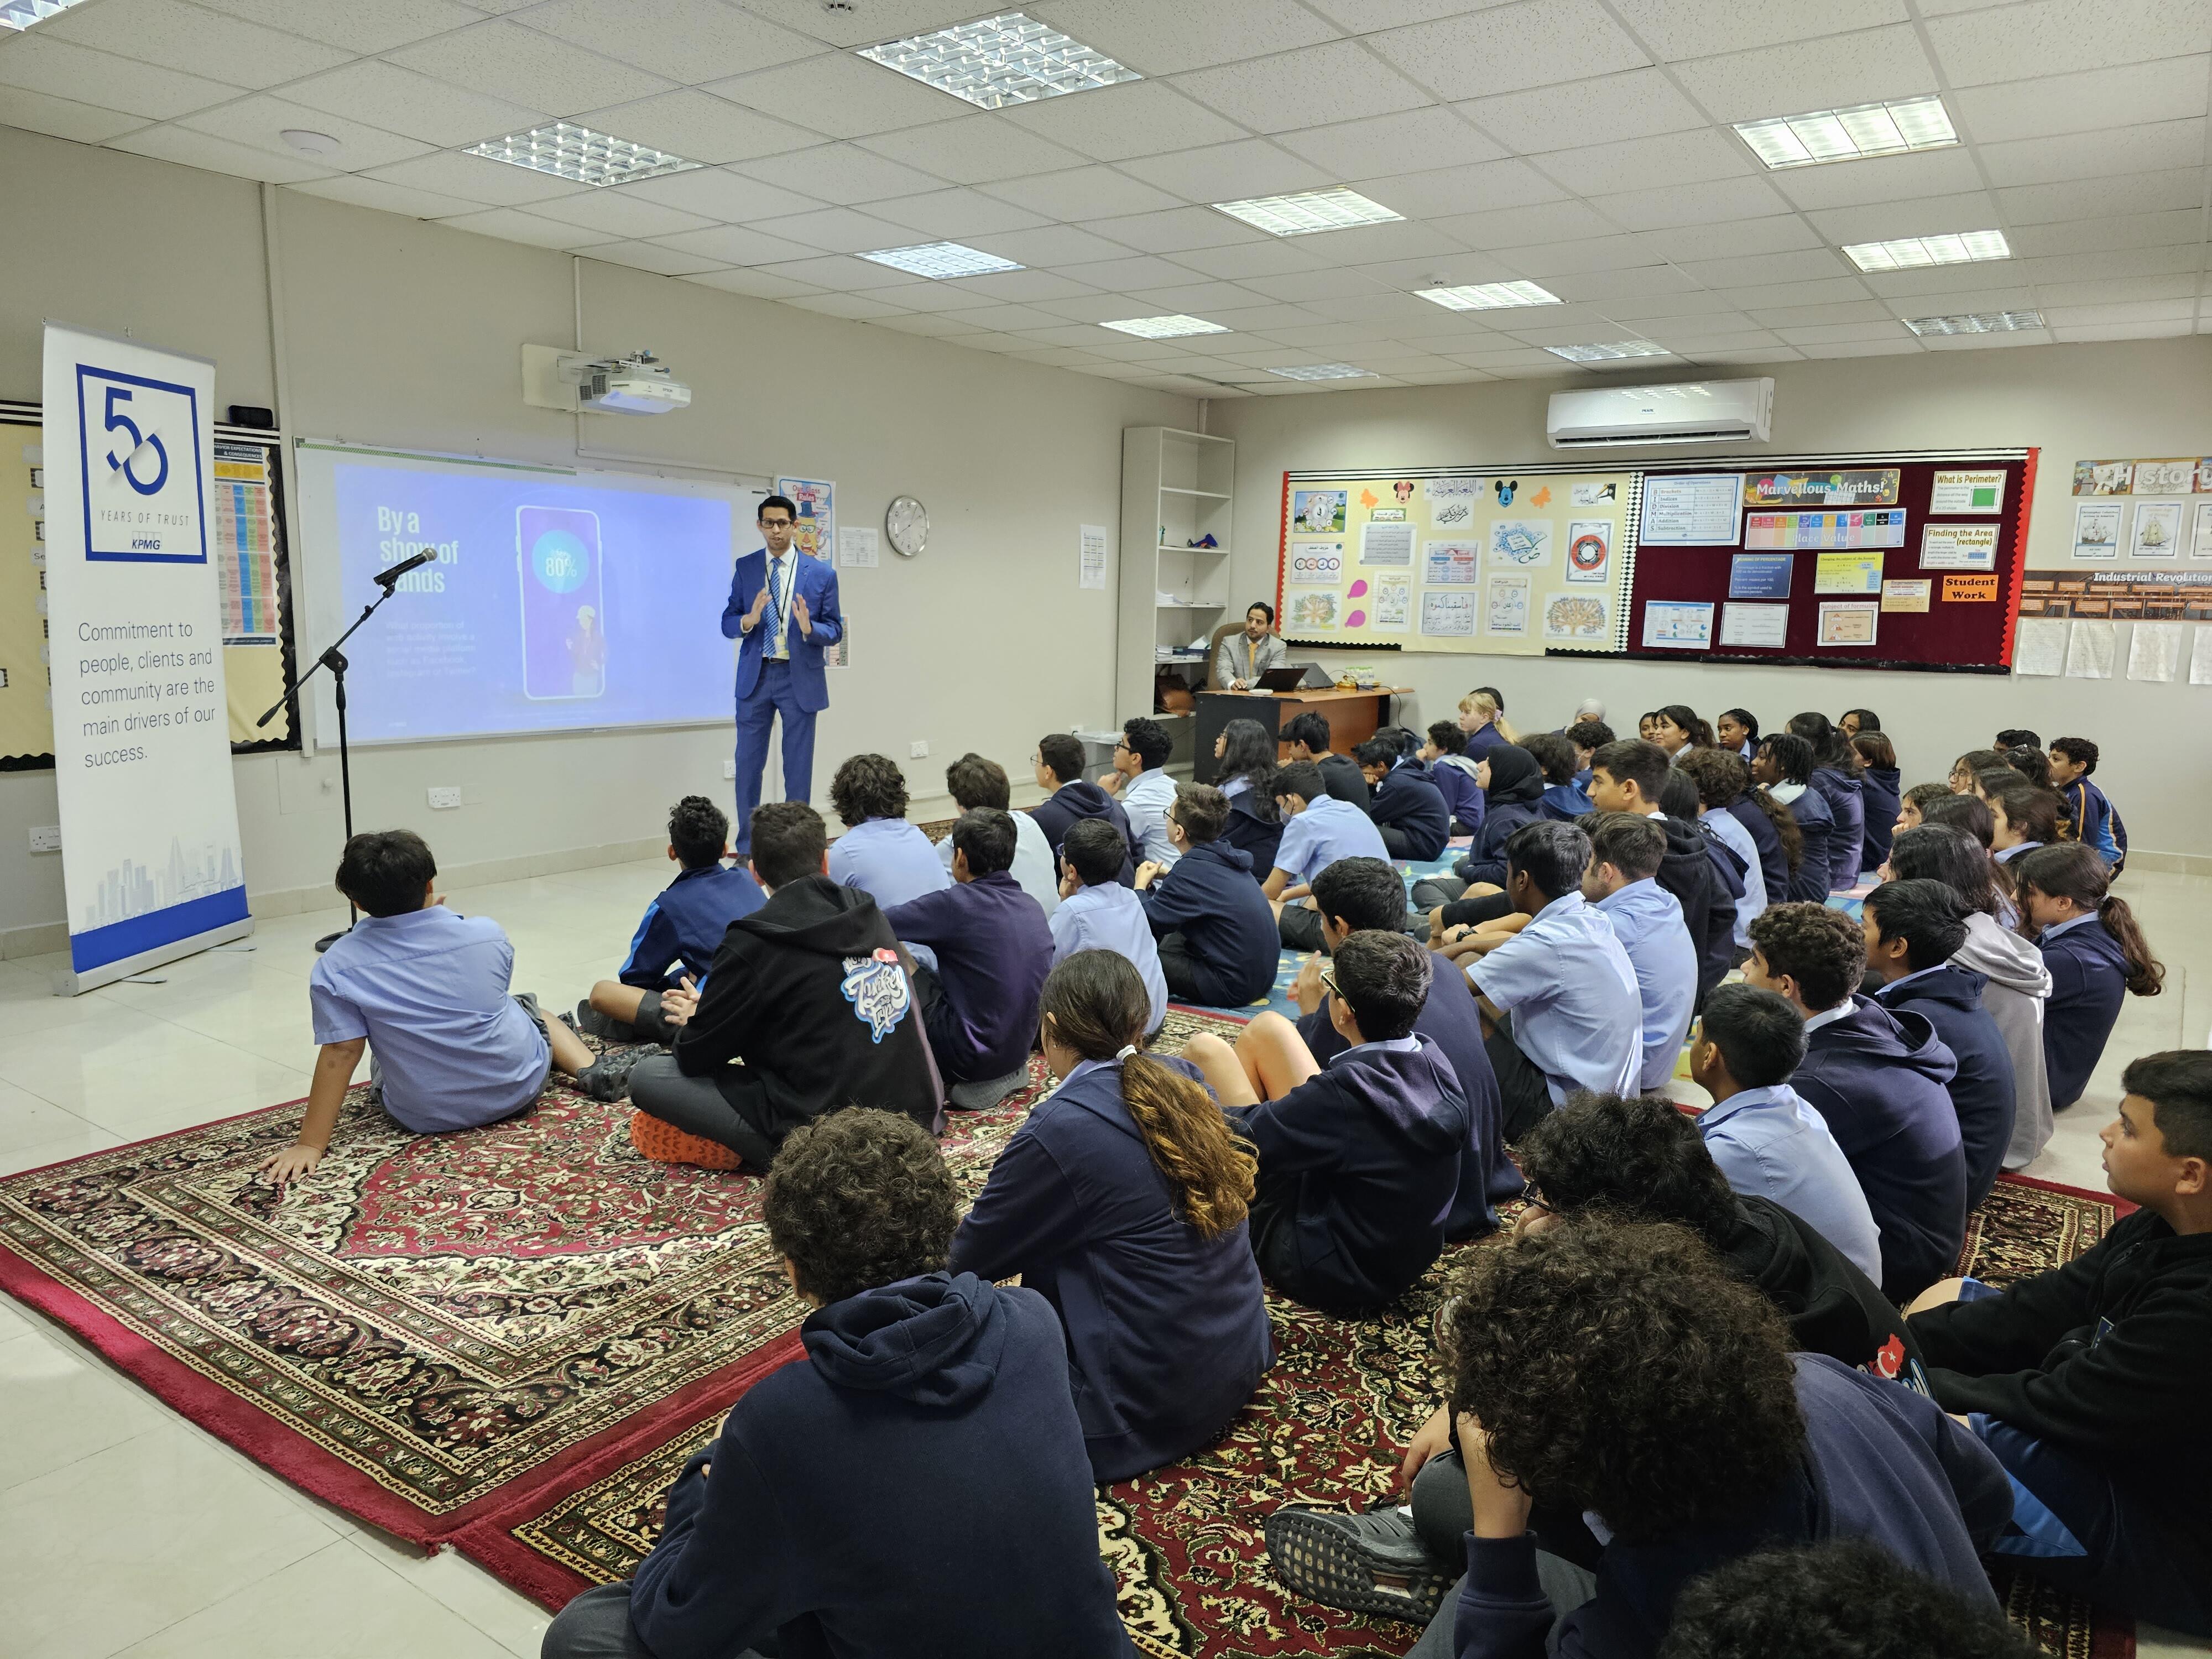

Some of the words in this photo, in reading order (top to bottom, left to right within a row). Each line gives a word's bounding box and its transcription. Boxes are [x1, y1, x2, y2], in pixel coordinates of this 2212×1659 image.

[1937, 475, 1955, 484] What
[1957, 474, 1962, 483] is
[1964, 474, 2002, 483] Perimeter?
[1757, 481, 1831, 495] Marvellous
[1837, 480, 1885, 493] Maths!
[799, 493, 815, 501] Rules
[101, 510, 132, 523] YEARS
[138, 513, 151, 523] OF
[158, 514, 190, 526] TRUST
[378, 506, 403, 535] By
[408, 512, 420, 534] a
[1792, 533, 1819, 543] Place
[1823, 532, 1855, 543] Value
[1928, 529, 1958, 539] Finding
[132, 539, 161, 550] KPMG
[1957, 538, 1992, 547] (rectangle)
[439, 540, 459, 565] of
[546, 557, 577, 577] 80%
[1945, 578, 1996, 586] Student
[2093, 572, 2152, 582] Industrial
[79, 621, 174, 641] Commitment
[178, 622, 193, 637] to
[80, 653, 133, 678] people,
[138, 650, 184, 669] clients
[189, 648, 212, 666] and
[82, 681, 162, 705] community
[166, 682, 189, 696] are
[194, 676, 215, 694] the
[84, 715, 119, 737] main
[124, 712, 170, 731] drivers
[175, 706, 189, 724] of
[195, 708, 216, 722] our
[85, 747, 148, 768] success.
